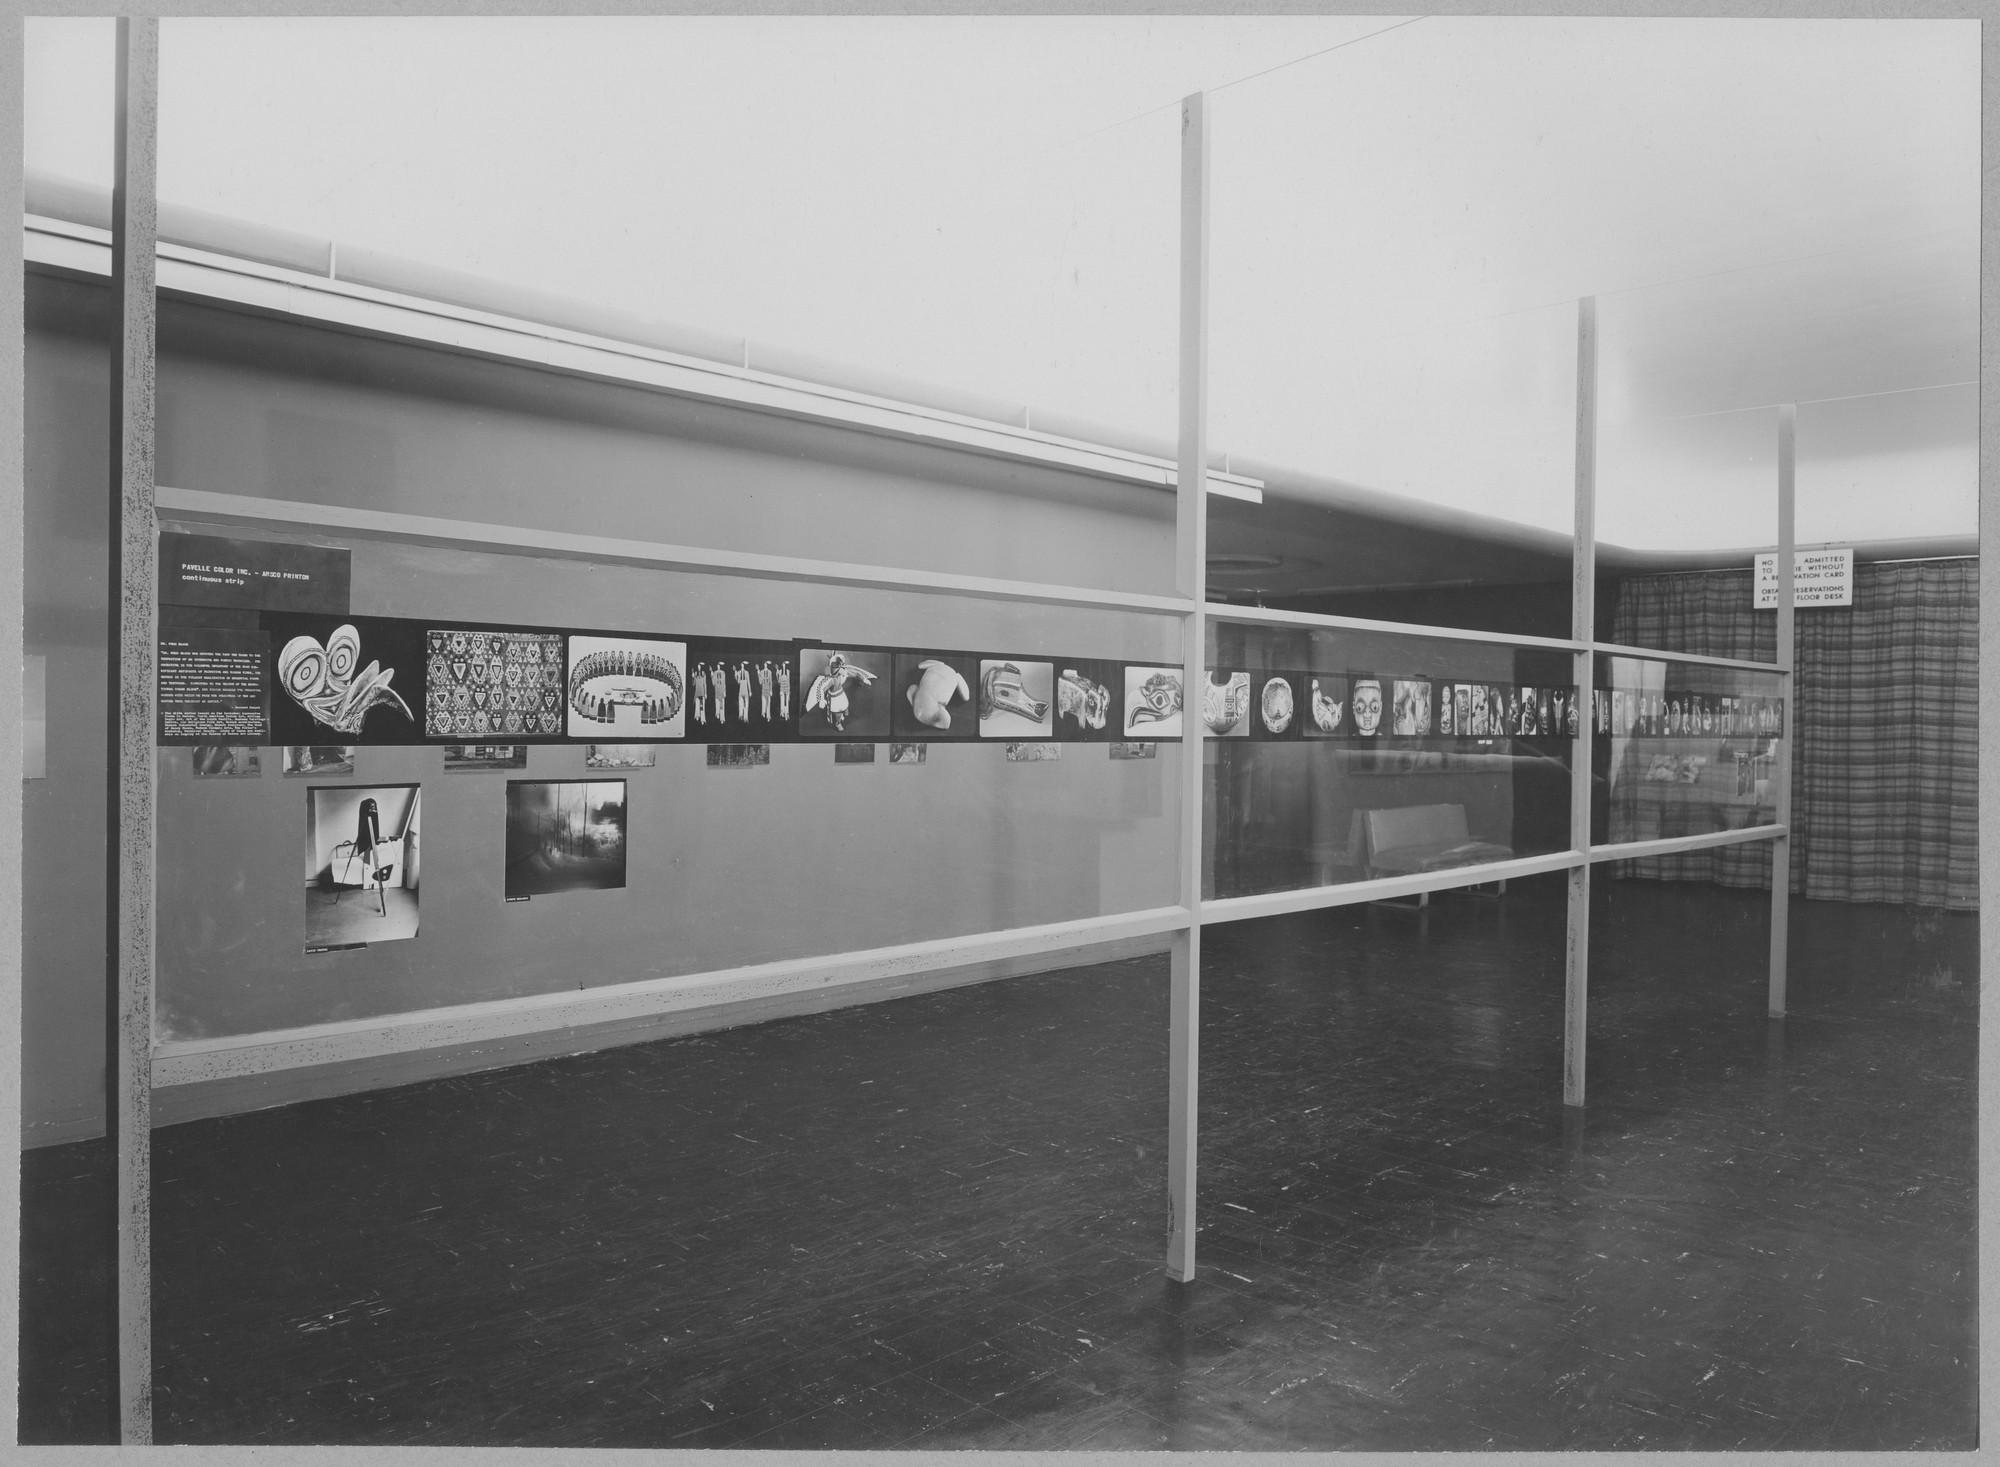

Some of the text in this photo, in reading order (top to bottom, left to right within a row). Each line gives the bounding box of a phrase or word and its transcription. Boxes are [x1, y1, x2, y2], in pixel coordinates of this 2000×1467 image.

[1804, 556, 1844, 564] ADMITTED
[182, 563, 211, 572] PAVELLE
[214, 566, 234, 574] COLOR
[237, 568, 251, 576] INC.
[1808, 563, 1844, 571] WITHOUT
[182, 574, 245, 586] continuous strip
